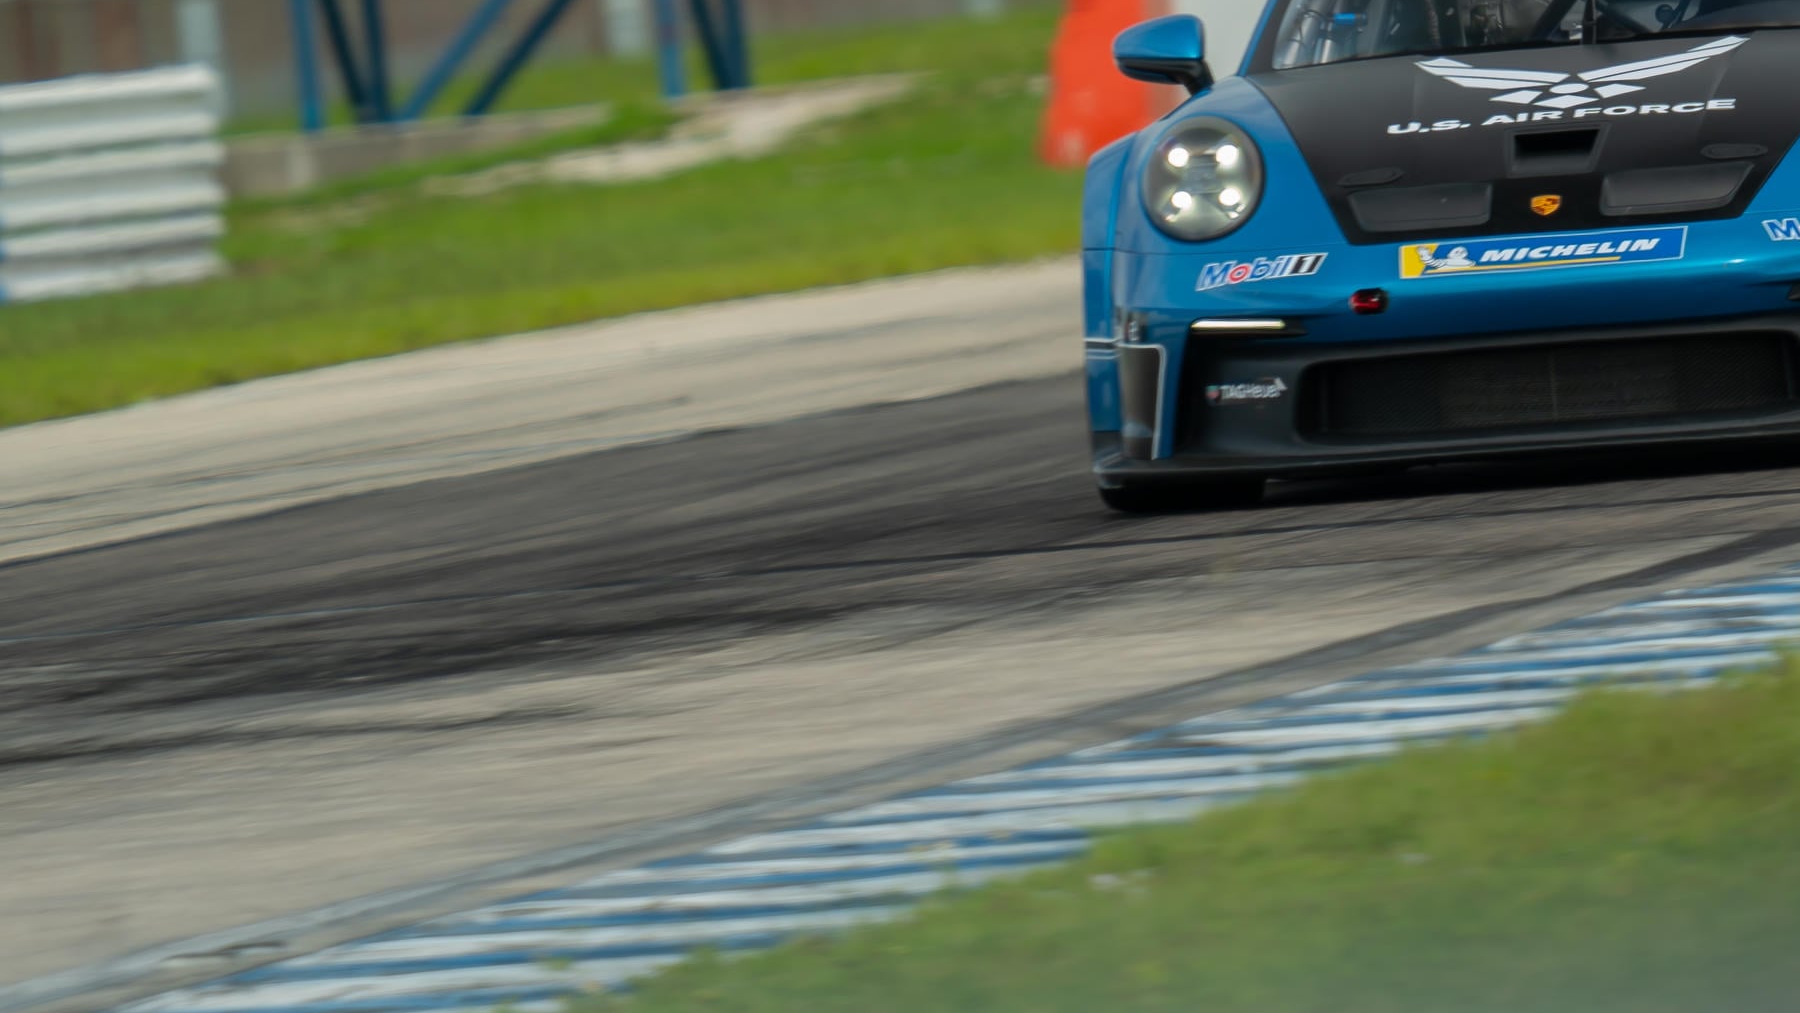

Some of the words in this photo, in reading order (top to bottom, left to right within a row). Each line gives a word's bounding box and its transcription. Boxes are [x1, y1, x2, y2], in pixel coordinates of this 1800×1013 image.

[1386, 119, 1472, 134] U.S.
[1481, 109, 1565, 126] AIR
[1573, 98, 1737, 118] FORCE
[1479, 238, 1661, 263] MICHELIN
[1196, 257, 1292, 290] Mobil
